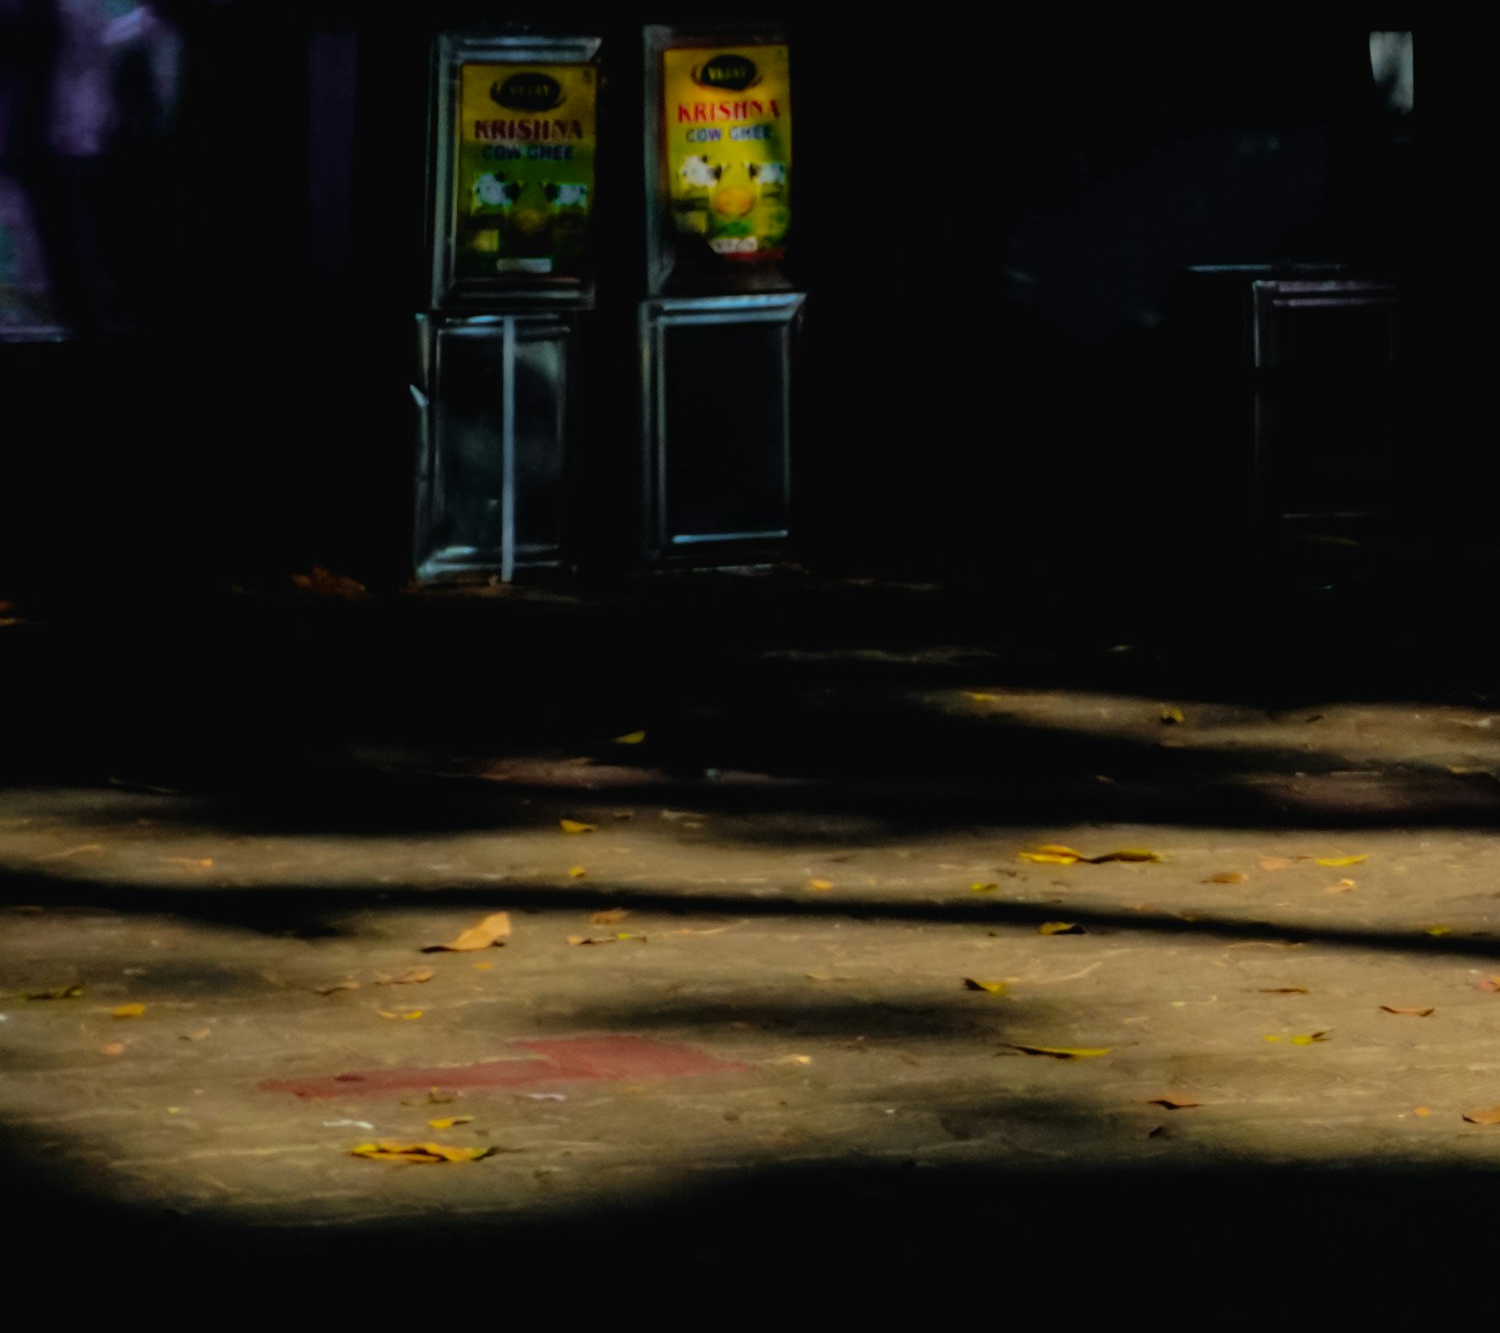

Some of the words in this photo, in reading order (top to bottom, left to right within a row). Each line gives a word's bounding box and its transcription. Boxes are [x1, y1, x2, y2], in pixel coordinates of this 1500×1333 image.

[677, 99, 780, 122] KRISHNA
[474, 119, 583, 140] KRISHNA
[686, 127, 722, 142] COW
[730, 124, 771, 141] GHEE
[481, 145, 521, 161] COW
[527, 145, 574, 161] GHEE
